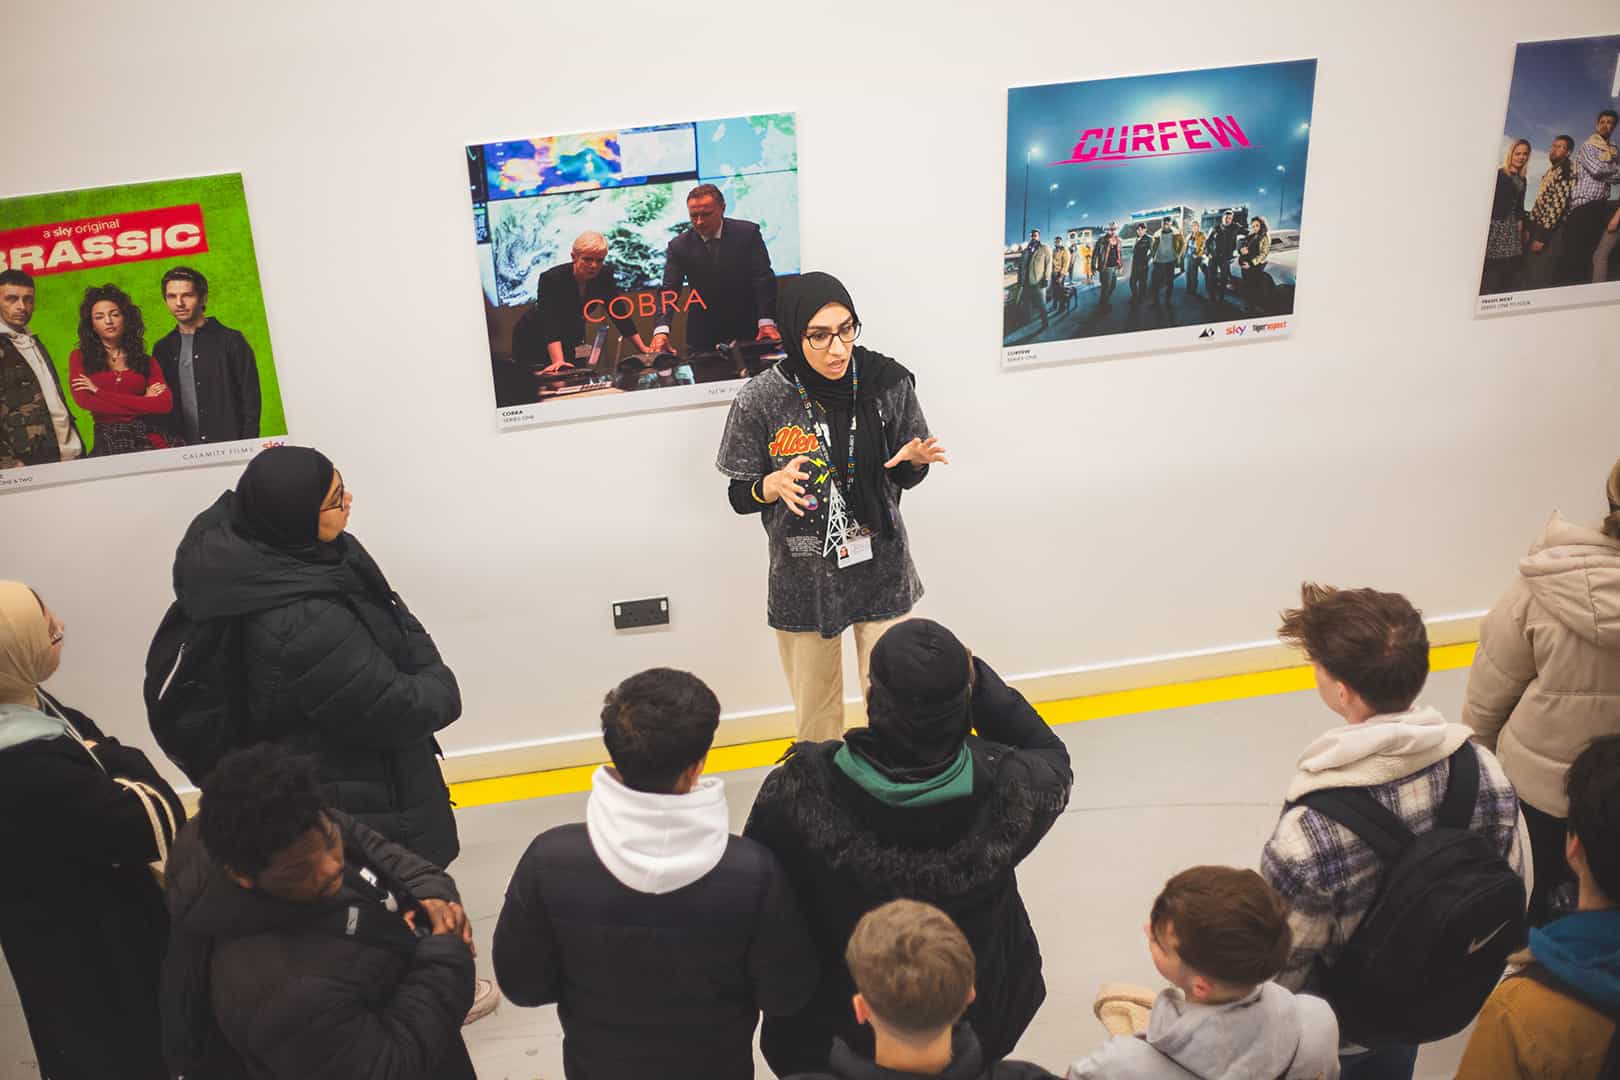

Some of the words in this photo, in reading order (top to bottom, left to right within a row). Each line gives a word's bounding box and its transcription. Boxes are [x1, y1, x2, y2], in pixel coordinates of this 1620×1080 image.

[1070, 115, 1251, 160] CURFEW
[43, 230, 51, 239] a
[53, 226, 73, 238] sky
[75, 219, 120, 234] original
[0, 223, 201, 273] RASSIC
[583, 288, 708, 323] COBRA
[1225, 325, 1247, 336] sky
[182, 449, 226, 460] CALAMITY
[228, 447, 255, 455] FILMS
